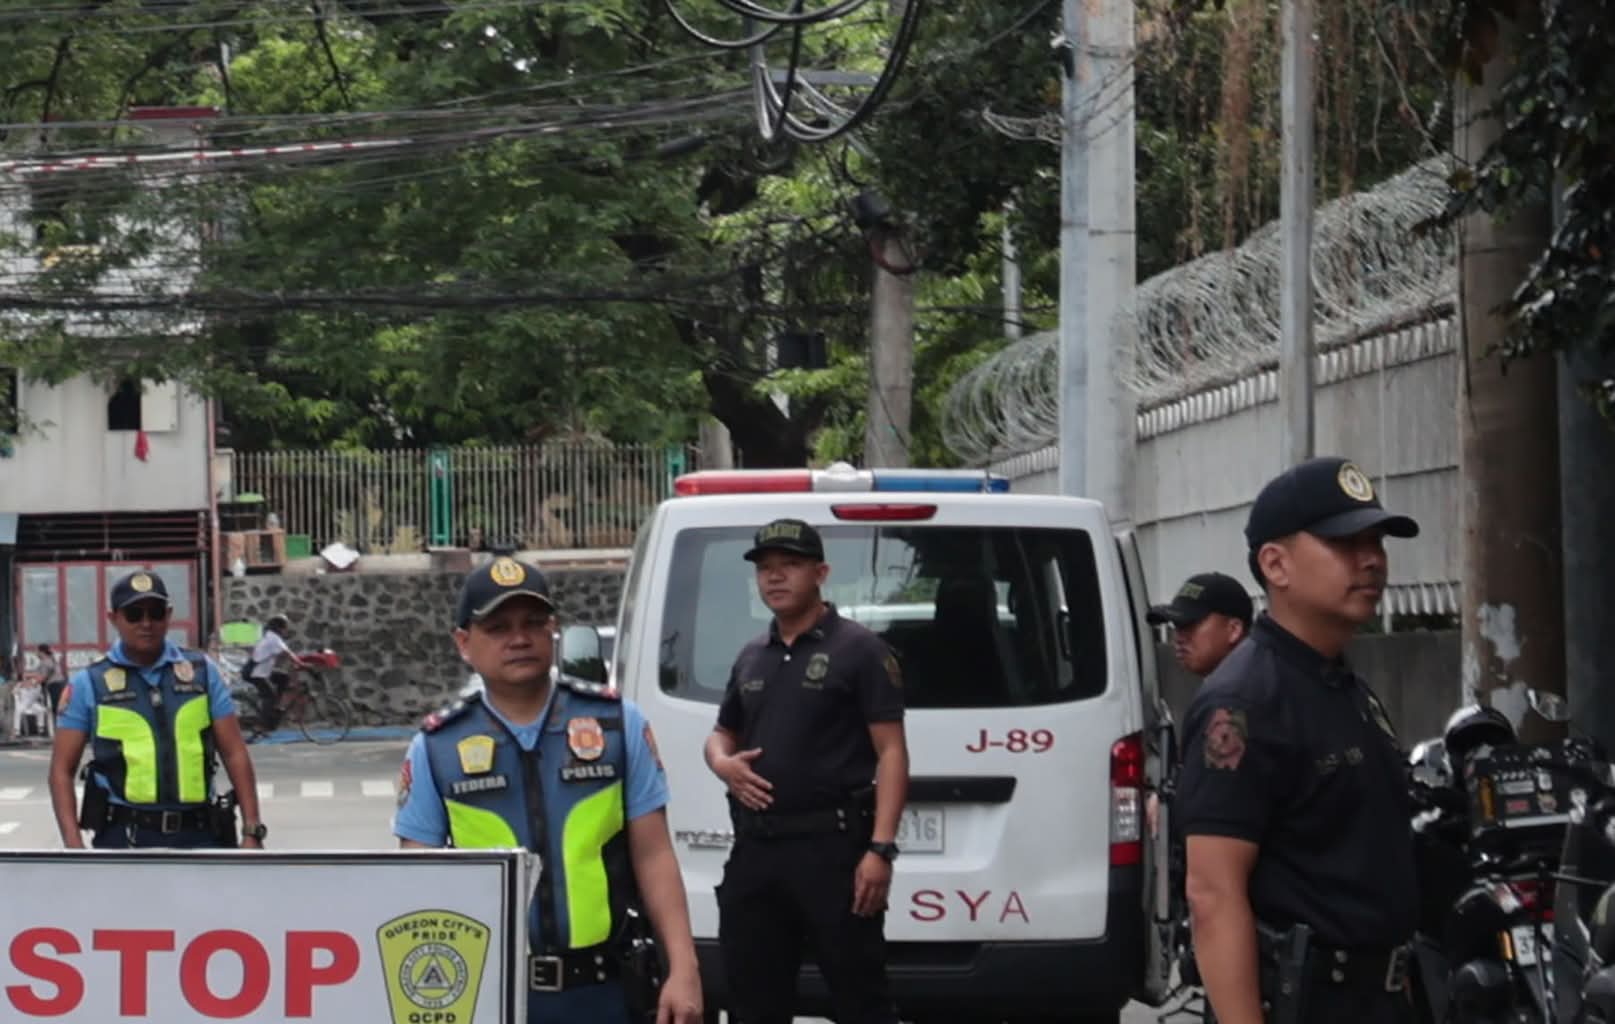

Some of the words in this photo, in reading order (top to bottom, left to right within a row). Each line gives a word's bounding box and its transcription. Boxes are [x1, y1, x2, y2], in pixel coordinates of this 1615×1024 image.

[965, 729, 1054, 754] J-89
[385, 918, 438, 939] QUEZON
[411, 931, 457, 941] PRIDE
[5, 927, 361, 1019] STOP
[408, 1011, 457, 1024] QCPD
